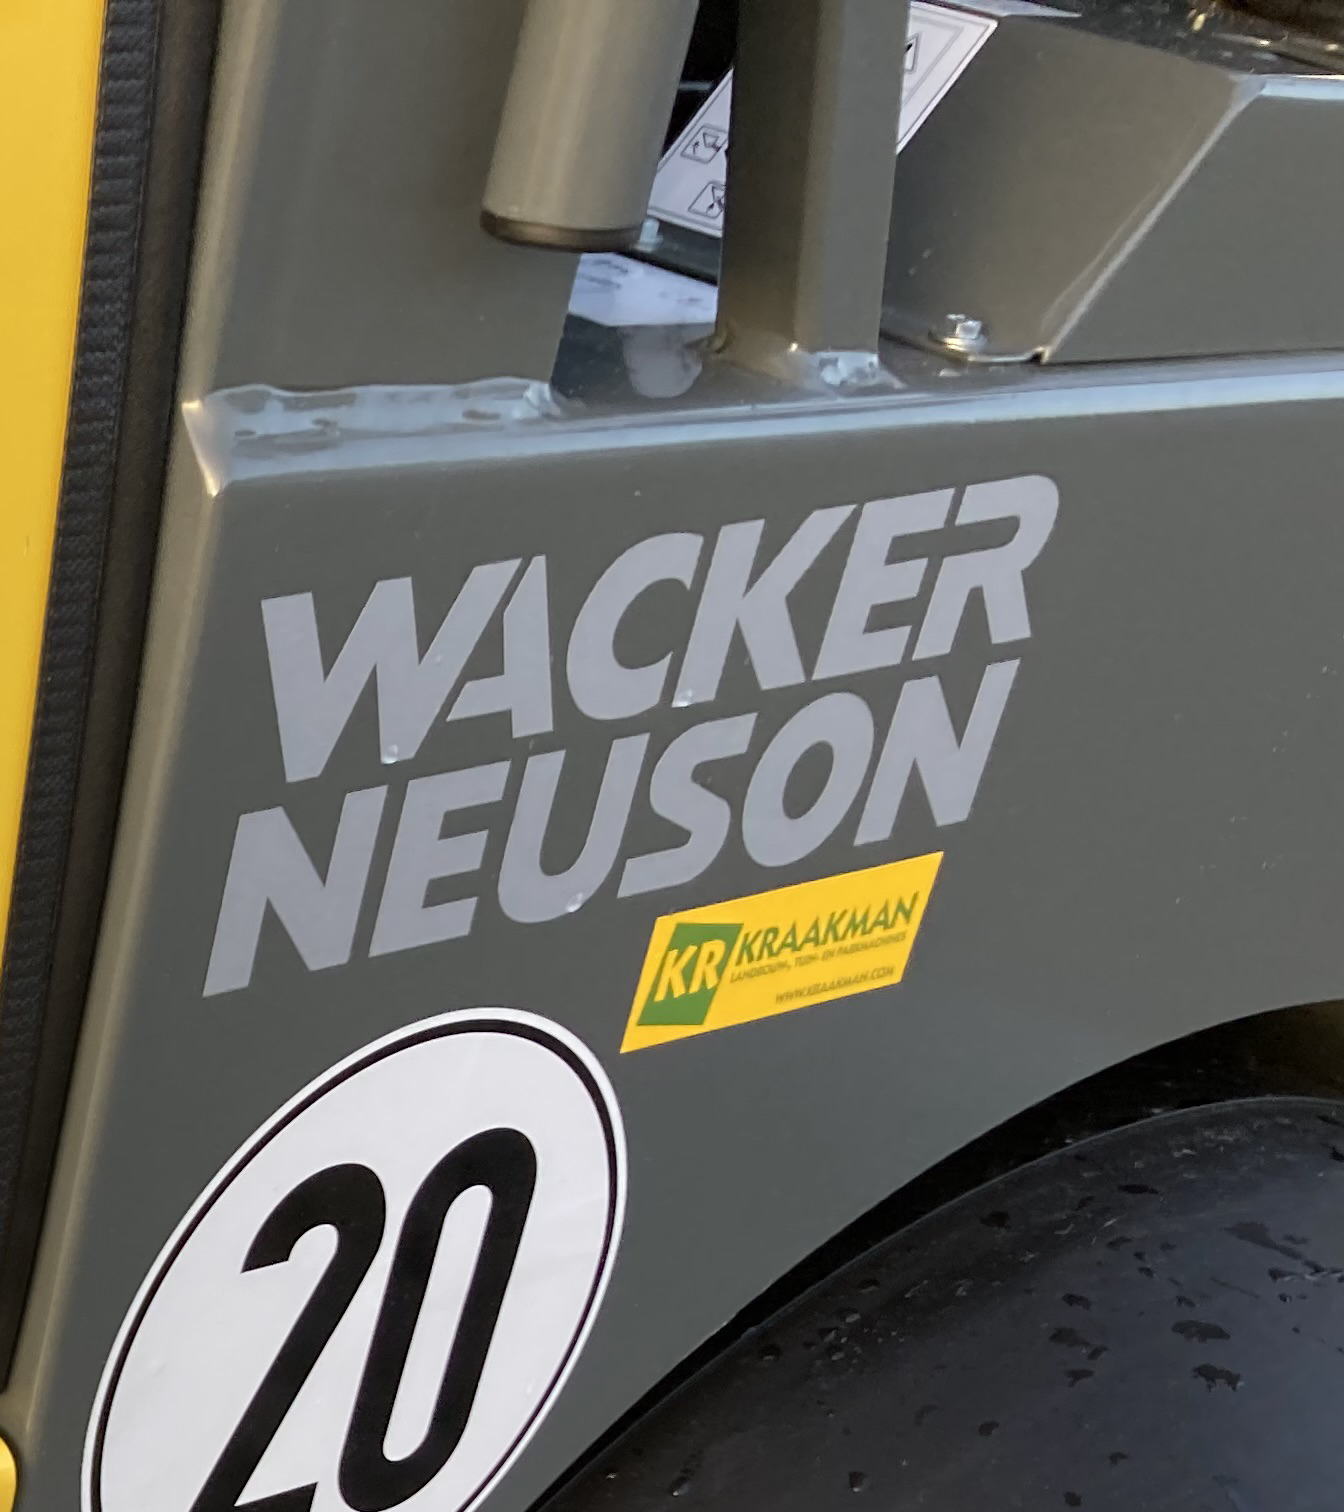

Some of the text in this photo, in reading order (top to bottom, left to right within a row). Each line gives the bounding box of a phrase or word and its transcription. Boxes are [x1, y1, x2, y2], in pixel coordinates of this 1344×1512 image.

[261, 474, 1060, 783] WACKER
[202, 658, 1021, 997] NEUSON
[654, 939, 727, 1003] KR
[735, 892, 919, 967] KRAAKMAN
